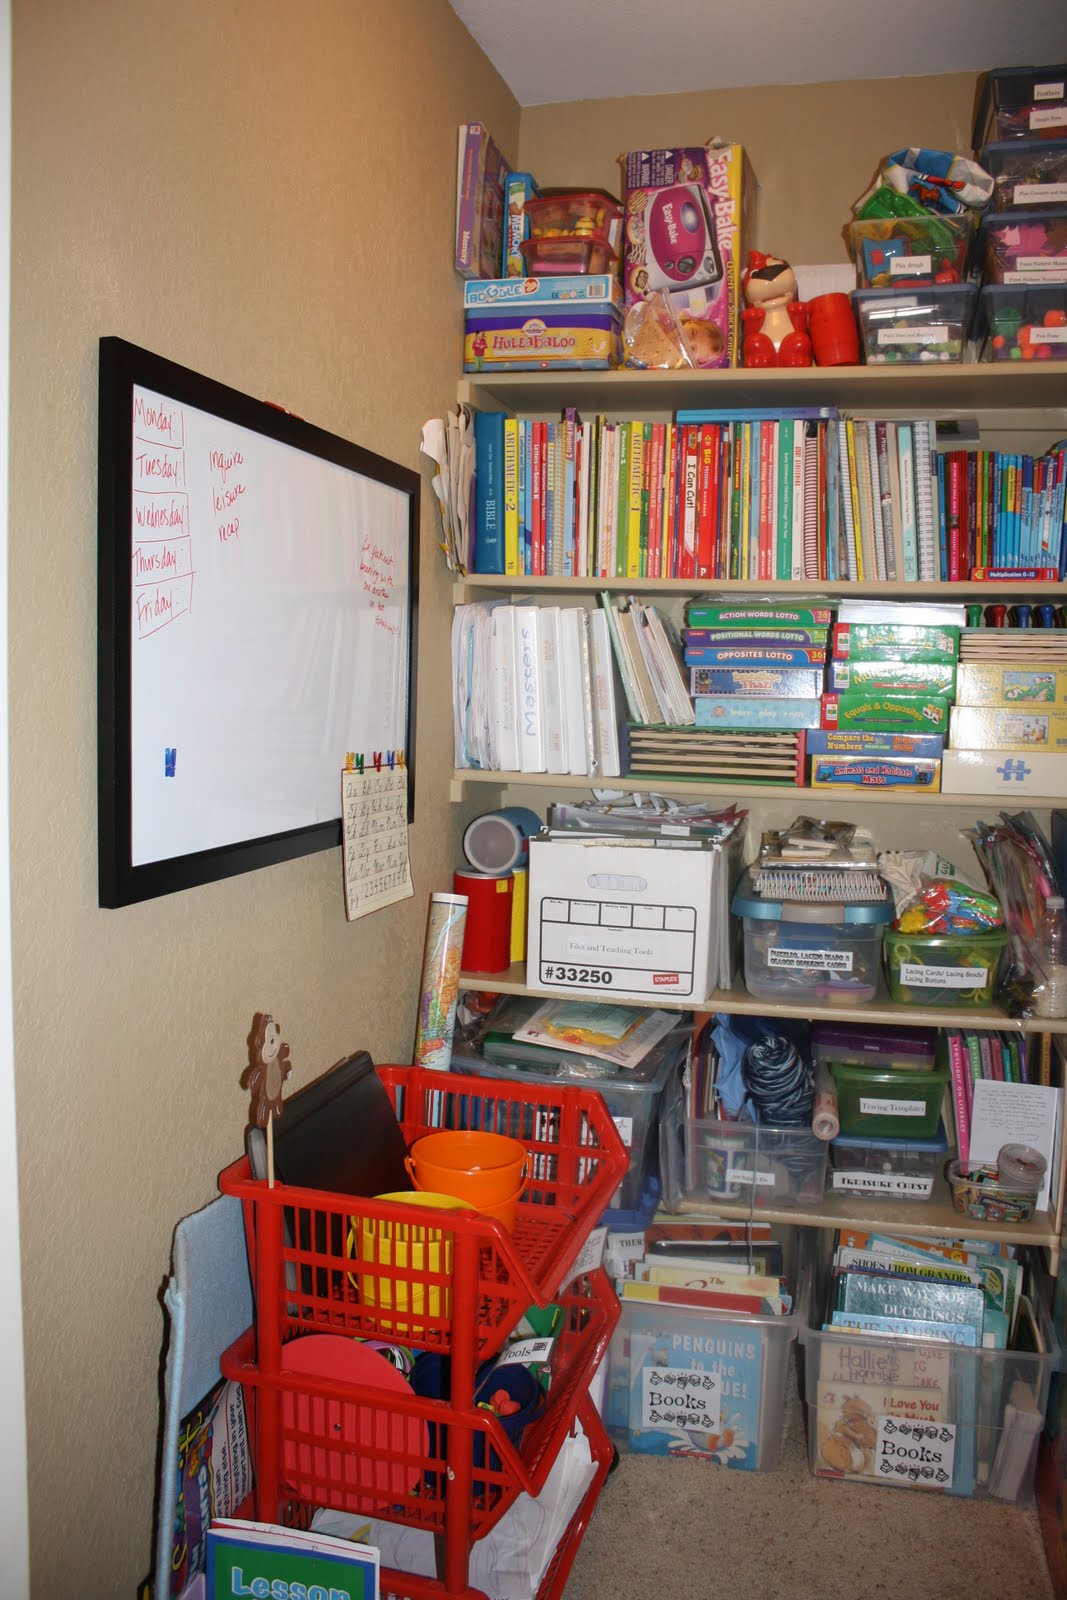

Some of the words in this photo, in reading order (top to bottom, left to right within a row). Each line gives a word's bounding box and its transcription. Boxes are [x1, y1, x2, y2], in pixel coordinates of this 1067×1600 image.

[708, 150, 737, 250] Easy-Bake
[662, 203, 678, 244] Easy-Bake
[510, 214, 521, 259] MEMORY
[460, 230, 470, 264] Memory
[726, 332, 734, 360] Center
[506, 431, 516, 496] ARITHMETIC
[632, 432, 642, 498] ARITHMETIC
[486, 500, 496, 530] BIBLE
[506, 503, 516, 512] 2
[218, 518, 240, 542] recap
[719, 612, 746, 620] ACTION
[776, 612, 799, 620] LOTTO
[710, 632, 752, 641] POSITIONAL
[782, 632, 804, 641] LOTTO
[814, 631, 824, 639] 36
[717, 650, 763, 660] OPPOSITES
[766, 652, 793, 660] LOTTO
[522, 628, 536, 736] Masters
[730, 708, 752, 716] learn
[758, 710, 776, 719] play
[844, 704, 872, 720] Equals
[883, 702, 923, 721] Opposites
[827, 733, 860, 742] Compare
[862, 734, 874, 742] the
[835, 766, 864, 775] Animals
[880, 766, 912, 777] Habitats
[862, 776, 886, 784] Mats
[570, 942, 585, 950] Files
[601, 945, 632, 955] Teaching
[633, 947, 654, 956] Tools
[545, 966, 613, 984] #33250
[946, 970, 965, 978] Lacing
[953, 1044, 962, 1082] SPOTLIGHT
[863, 1103, 888, 1112] Tracing
[889, 1104, 924, 1113] Templates
[841, 1177, 893, 1188] TREASURE
[896, 1182, 929, 1191] CHEST
[852, 1258, 886, 1270] SHOES
[888, 1264, 918, 1276] FROM
[920, 1267, 972, 1284] GRANDPA
[709, 1277, 725, 1286] The
[857, 1281, 896, 1296] MAKE
[902, 1286, 930, 1298] WAY
[936, 1289, 964, 1303] FOR
[884, 1303, 964, 1322] DUCKLINGS
[672, 1333, 756, 1360] PENGUINS
[690, 1358, 704, 1372] to
[712, 1359, 736, 1377] the
[650, 1392, 706, 1410] Books
[890, 1397, 916, 1409] Love
[920, 1400, 939, 1411] You
[236, 1412, 244, 1438] than
[881, 1440, 942, 1463] Books
[220, 1471, 230, 1516] nything
[231, 1566, 350, 1600] Lesson
